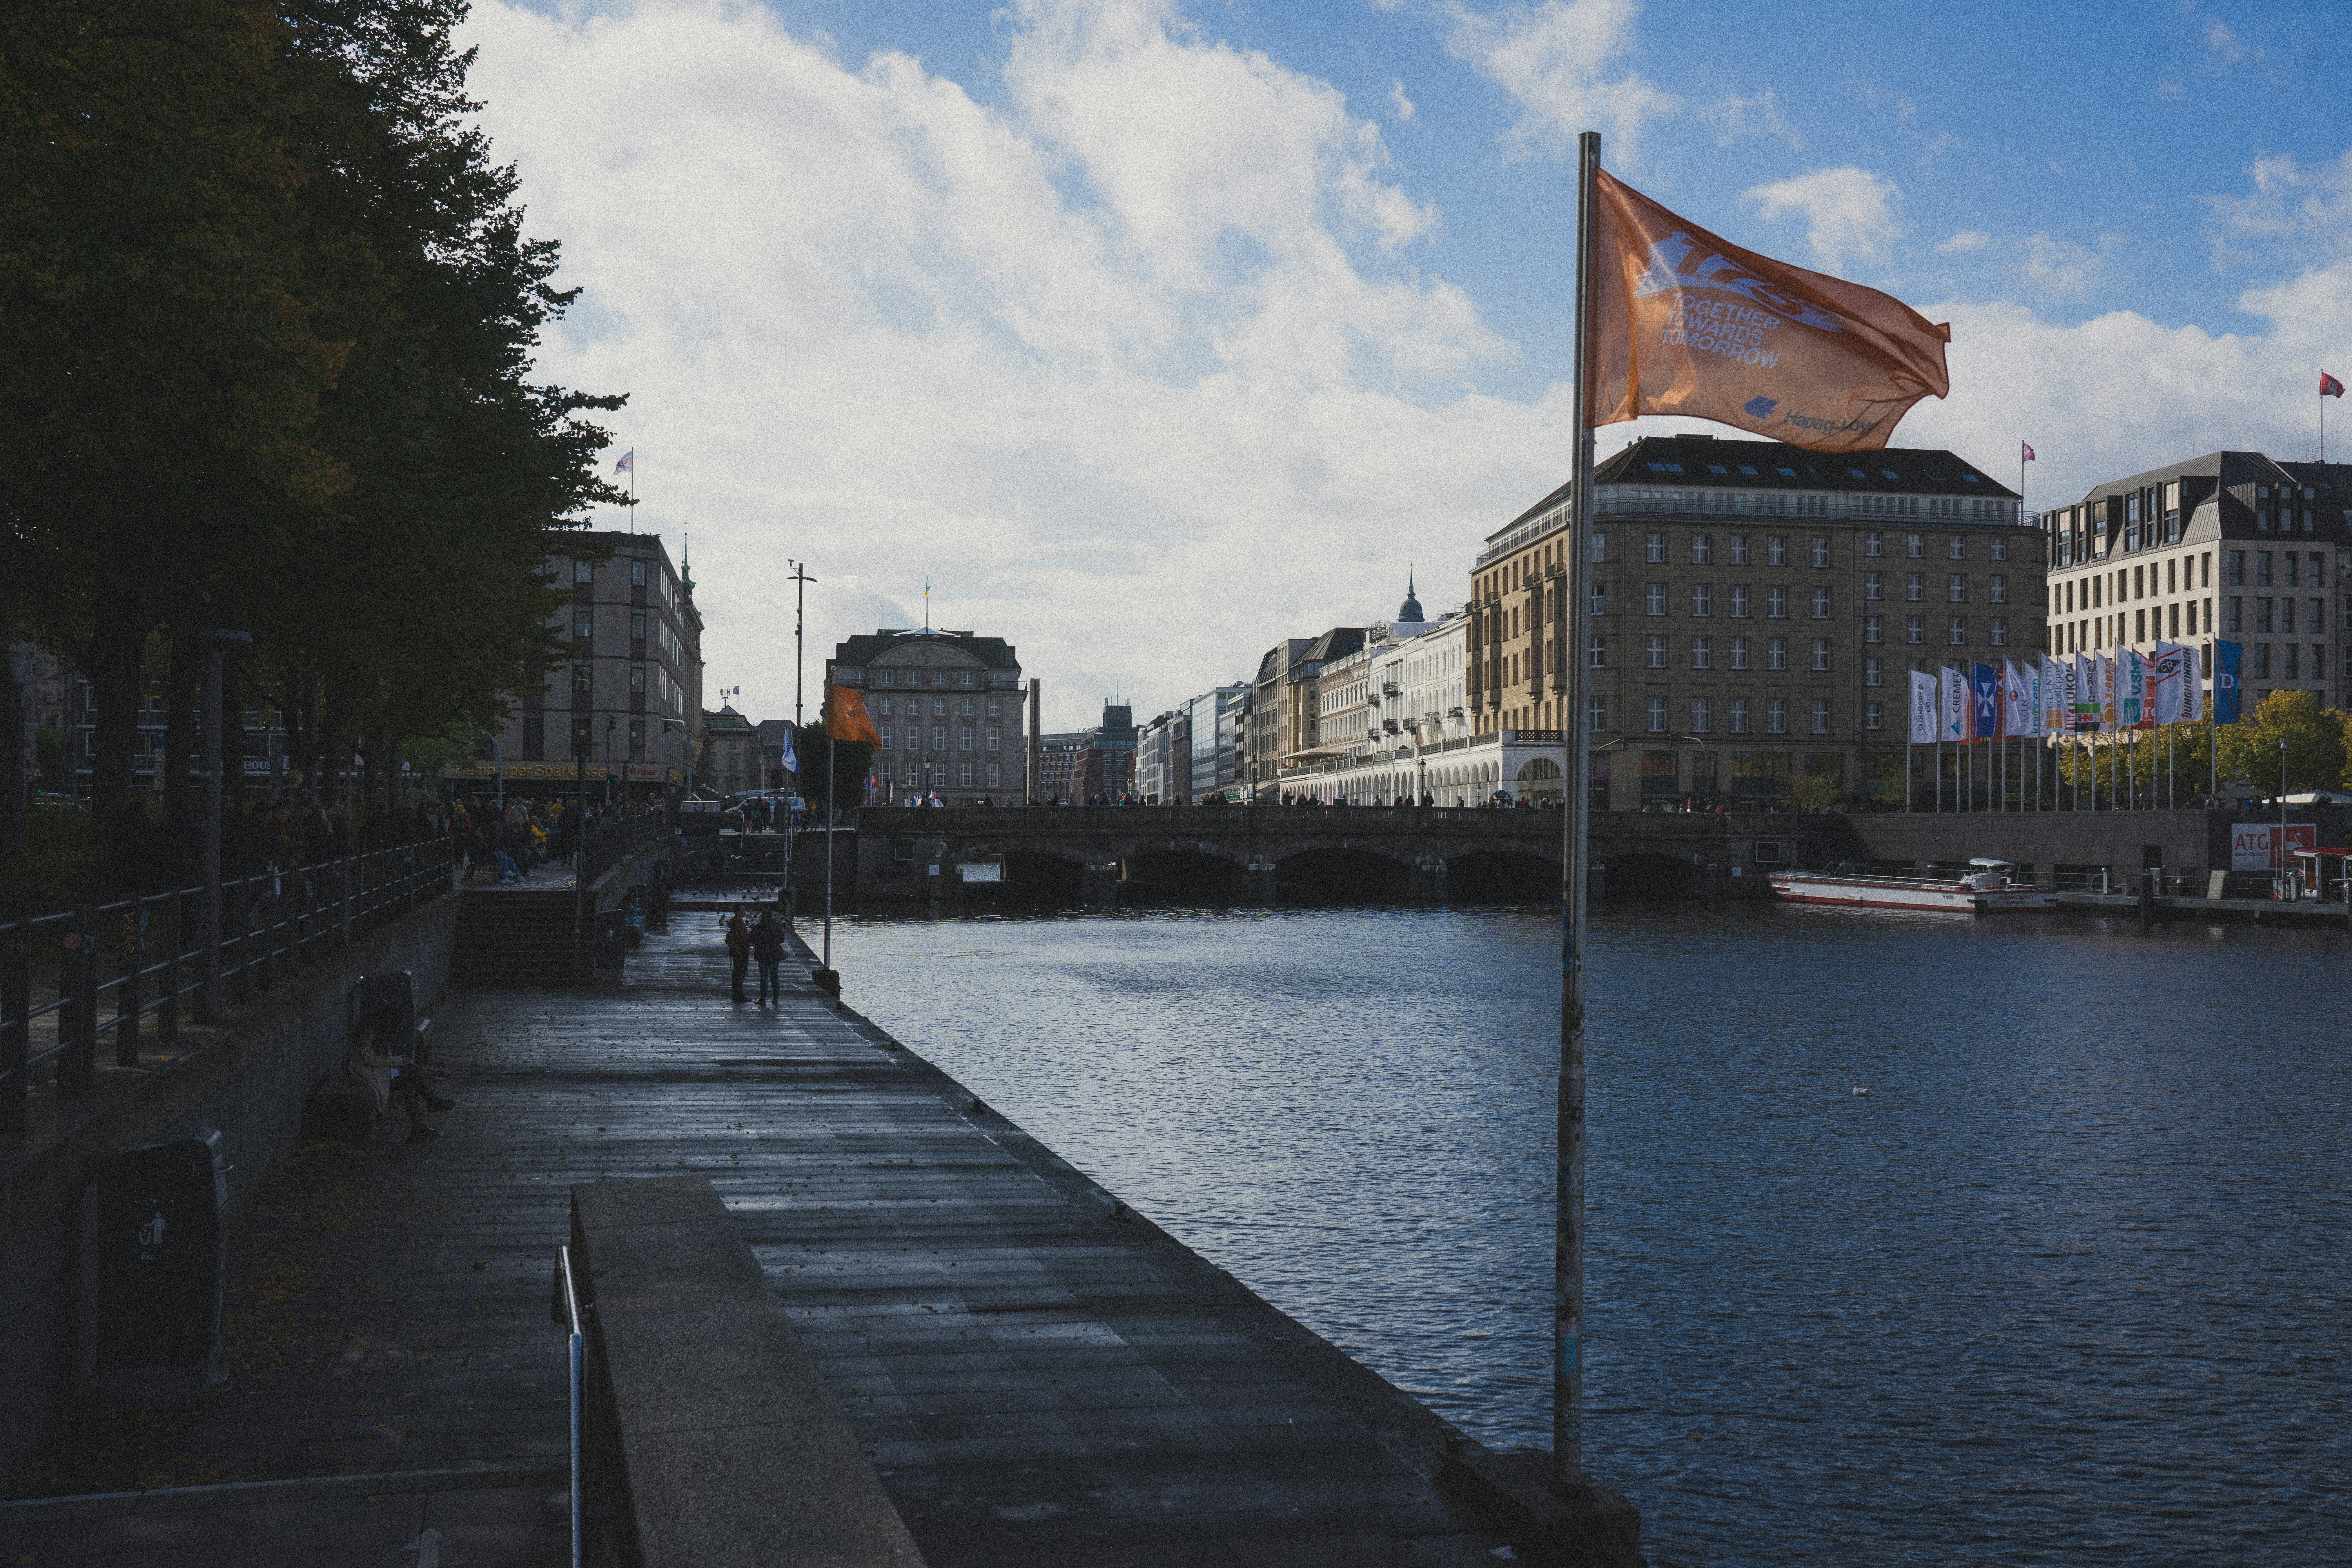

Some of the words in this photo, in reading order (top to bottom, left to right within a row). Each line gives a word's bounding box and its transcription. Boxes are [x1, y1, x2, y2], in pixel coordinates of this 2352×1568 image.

[1672, 293, 1780, 331] TOGETHER
[1666, 310, 1764, 346] TOWARDS
[1661, 328, 1781, 369] TOMORROW
[2160, 661, 2174, 671] CR
[1953, 672, 1961, 713] CREMER
[2182, 647, 2192, 719] JUNGHEINRICH
[2219, 672, 2235, 689] D
[243, 761, 270, 769] HOUS
[637, 768, 656, 777] Haspa
[2234, 833, 2269, 850] ATG
